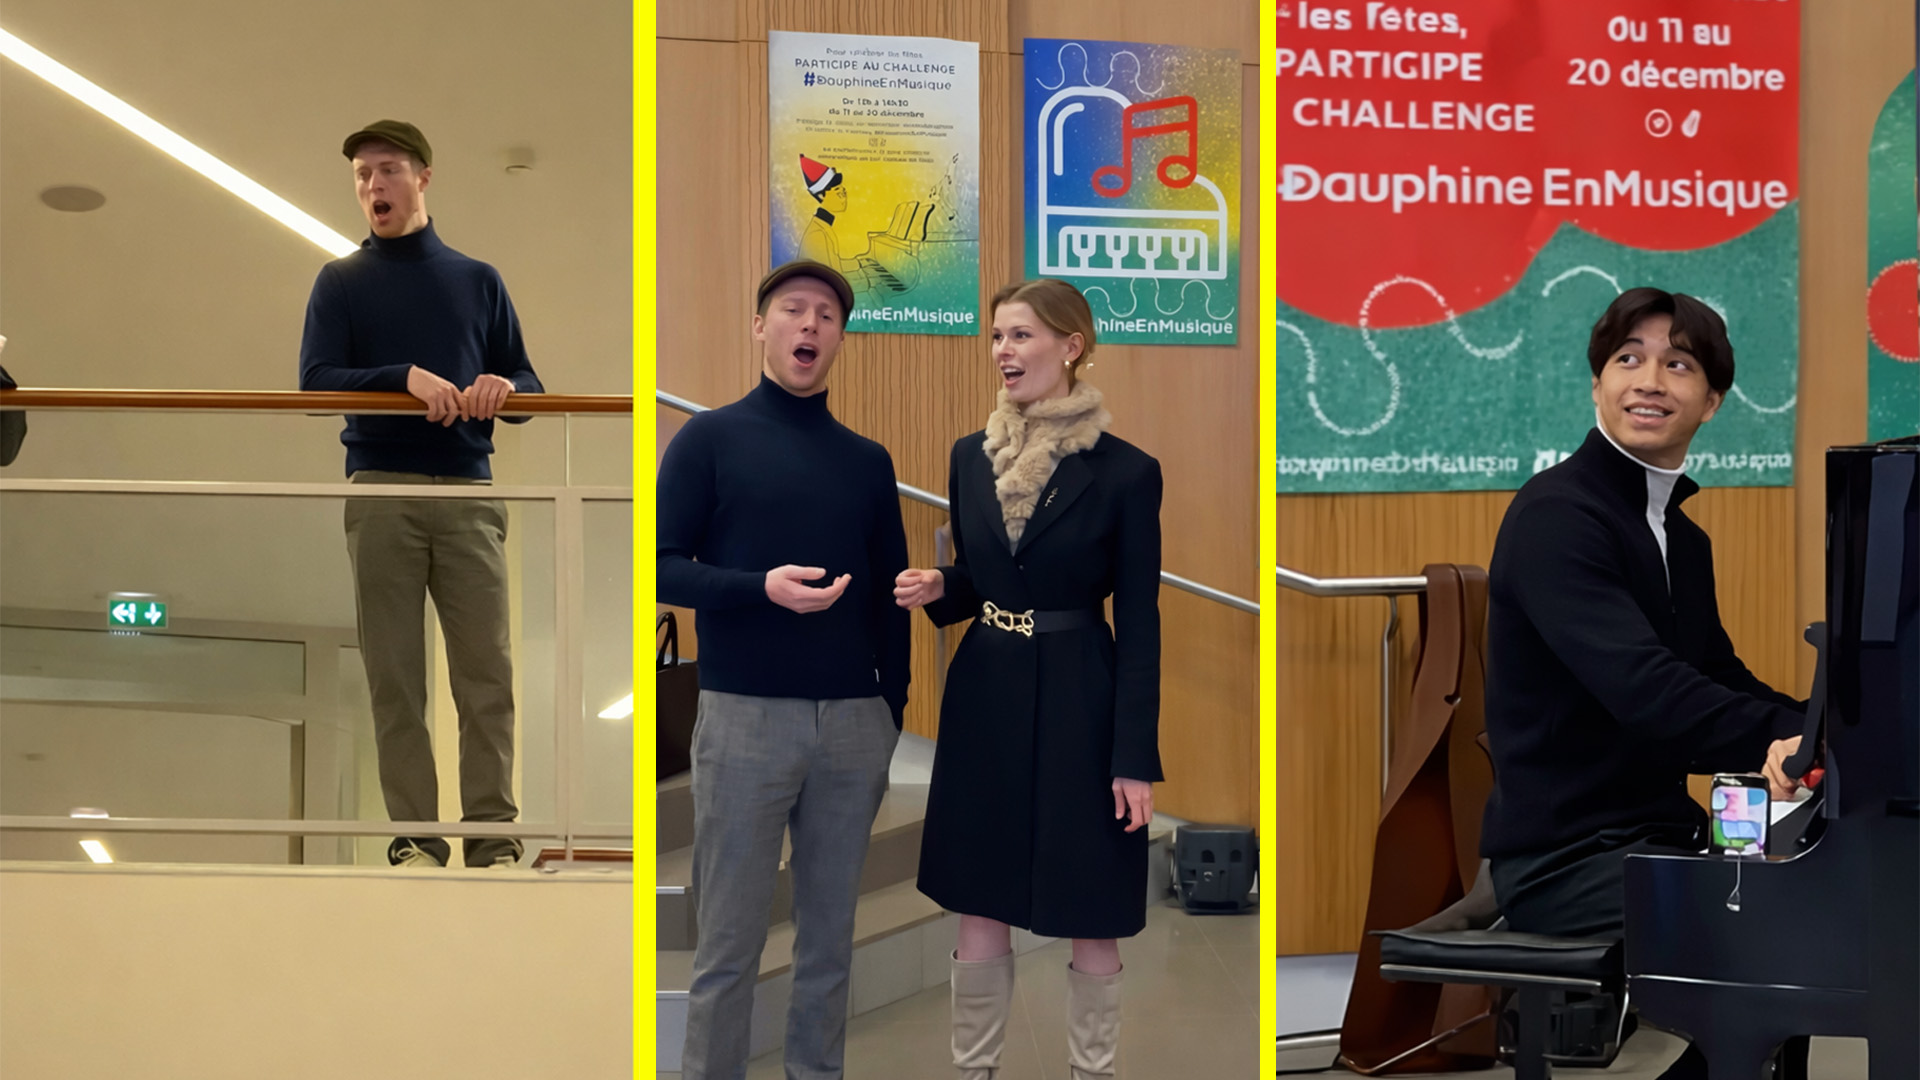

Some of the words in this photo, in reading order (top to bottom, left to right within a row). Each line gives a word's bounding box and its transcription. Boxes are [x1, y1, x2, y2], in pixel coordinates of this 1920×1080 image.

[1657, 17, 1684, 43] 11
[862, 61, 880, 71] AU
[1567, 58, 1611, 86] 20
[1620, 59, 1786, 91] décembre
[1292, 97, 1536, 132] CHALLENGE
[1542, 167, 1789, 217] EnMusique
